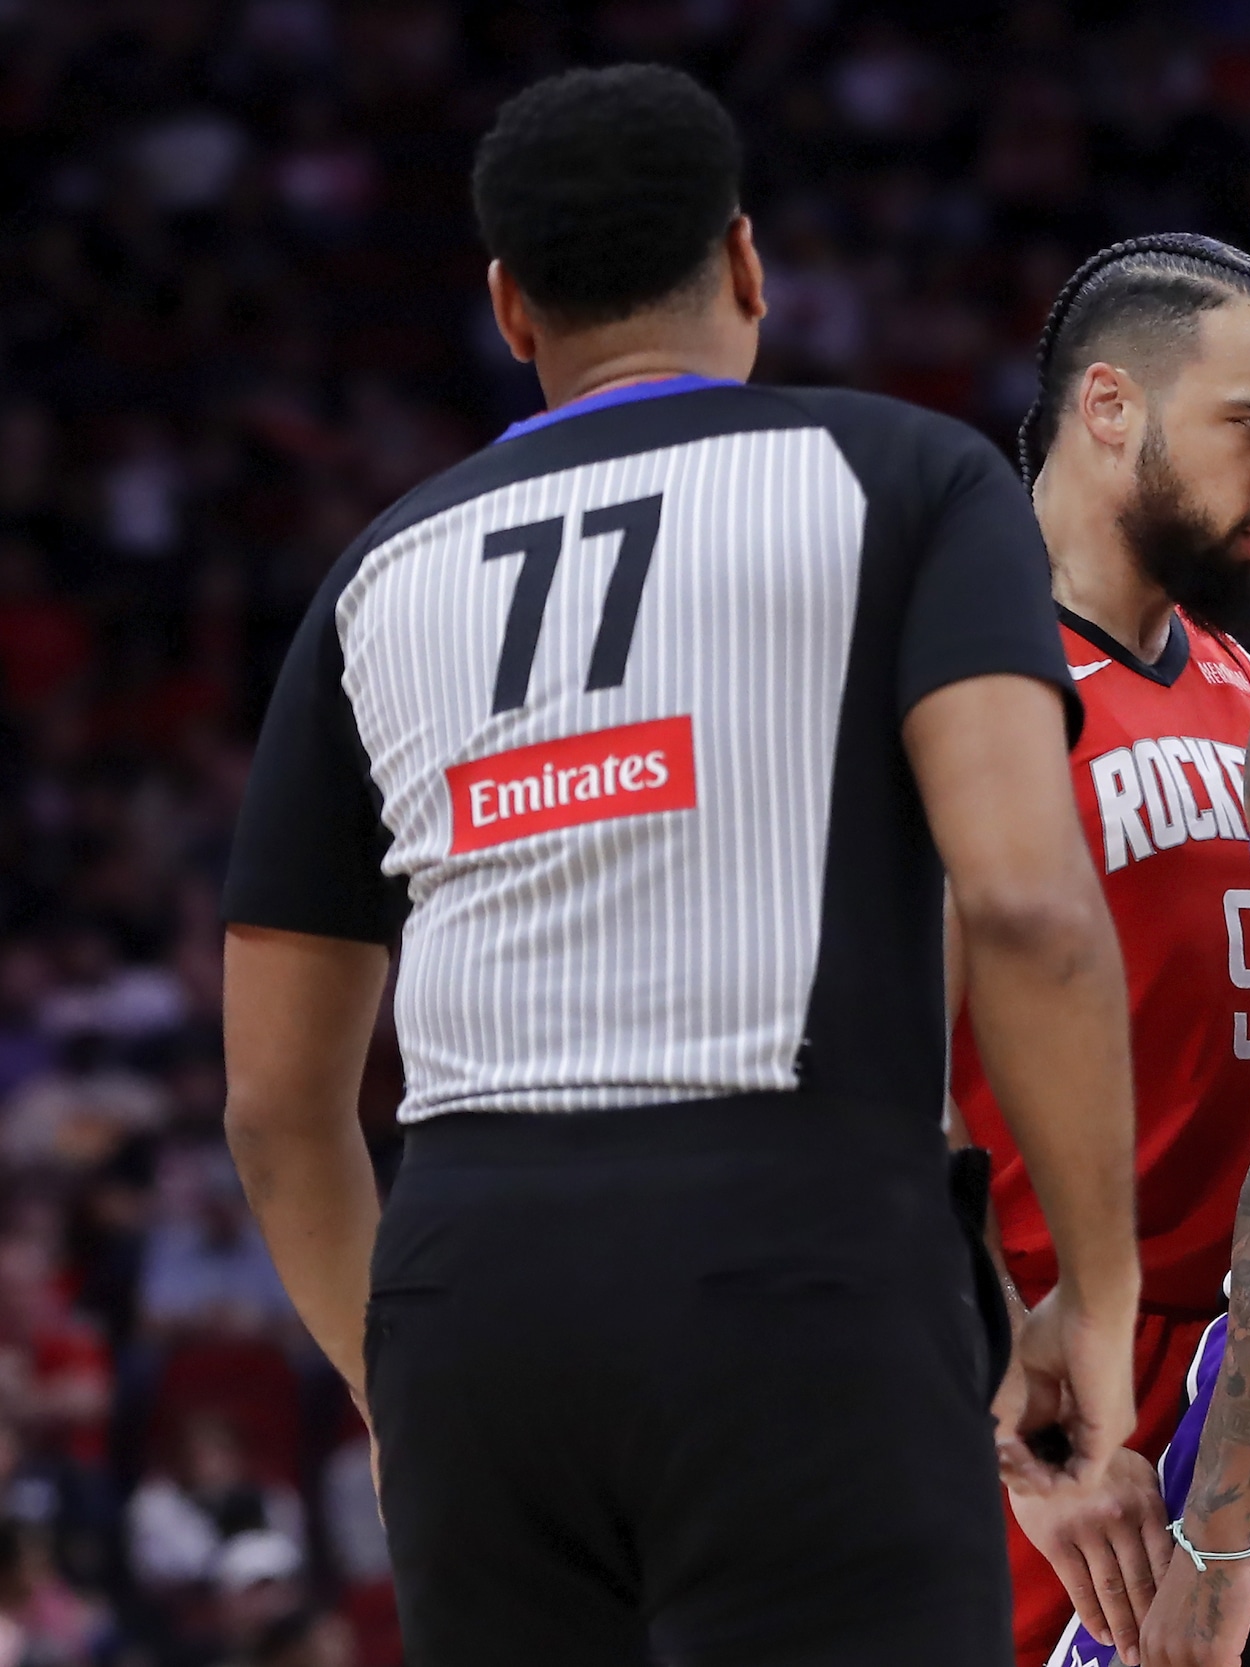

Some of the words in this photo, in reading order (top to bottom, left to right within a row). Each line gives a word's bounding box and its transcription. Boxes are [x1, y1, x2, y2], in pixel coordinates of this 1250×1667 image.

[482, 492, 664, 716] 77
[469, 749, 669, 827] Emirates
[1089, 736, 1250, 875] ROCK
